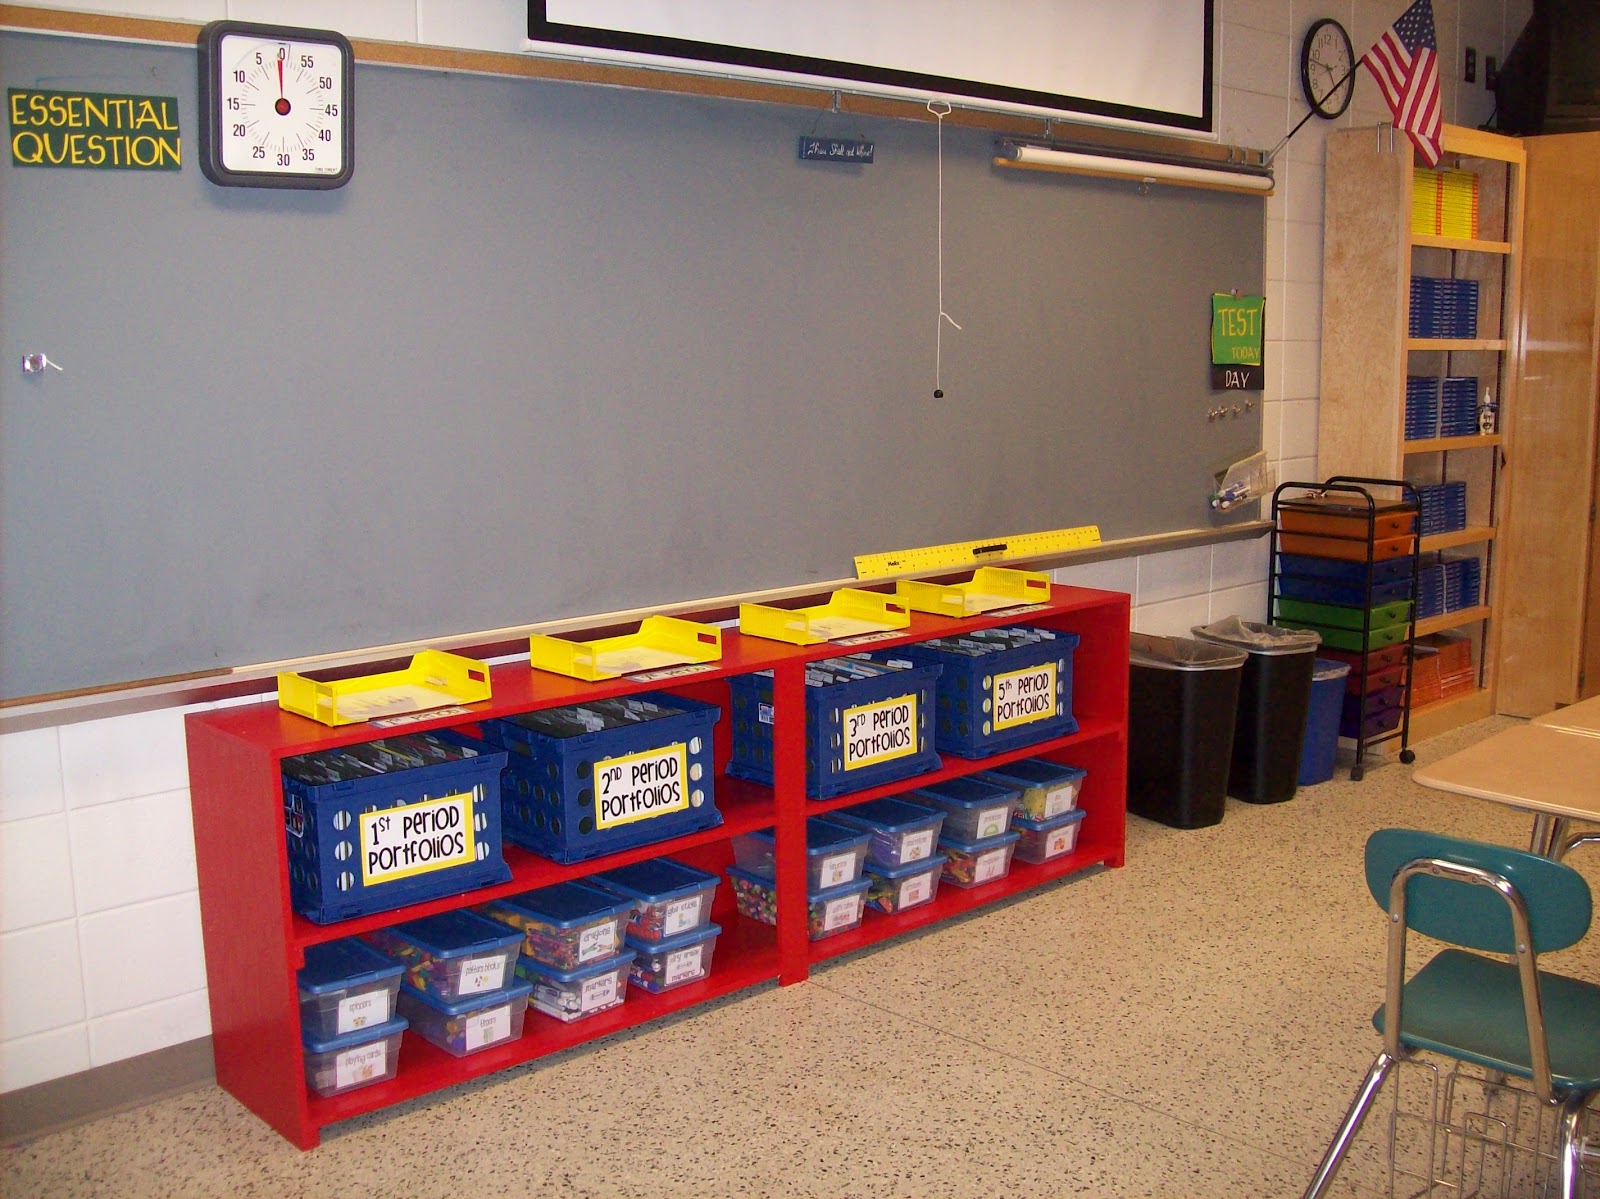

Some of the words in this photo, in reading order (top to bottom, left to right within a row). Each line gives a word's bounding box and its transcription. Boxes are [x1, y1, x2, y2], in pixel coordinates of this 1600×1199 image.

[255, 52, 263, 65] 5
[279, 47, 286, 61] 0
[301, 54, 314, 68] 55
[233, 70, 246, 83] 10
[319, 76, 332, 90] 50
[226, 97, 240, 111] 15
[325, 104, 338, 117] 45
[11, 94, 179, 131] ESSENTIAL
[233, 124, 246, 137] 20
[318, 129, 331, 142] 40
[12, 131, 182, 167] QUESTION
[252, 146, 265, 159] 25
[302, 148, 315, 161] 35
[276, 153, 290, 167] 30
[1218, 308, 1258, 336] TEST
[1232, 346, 1261, 360] TODAY
[1225, 370, 1250, 388] DAY
[998, 679, 1012, 701] 5th
[371, 815, 391, 846] 1st
[583, 926, 611, 942] crayons
[585, 976, 613, 992] markers
